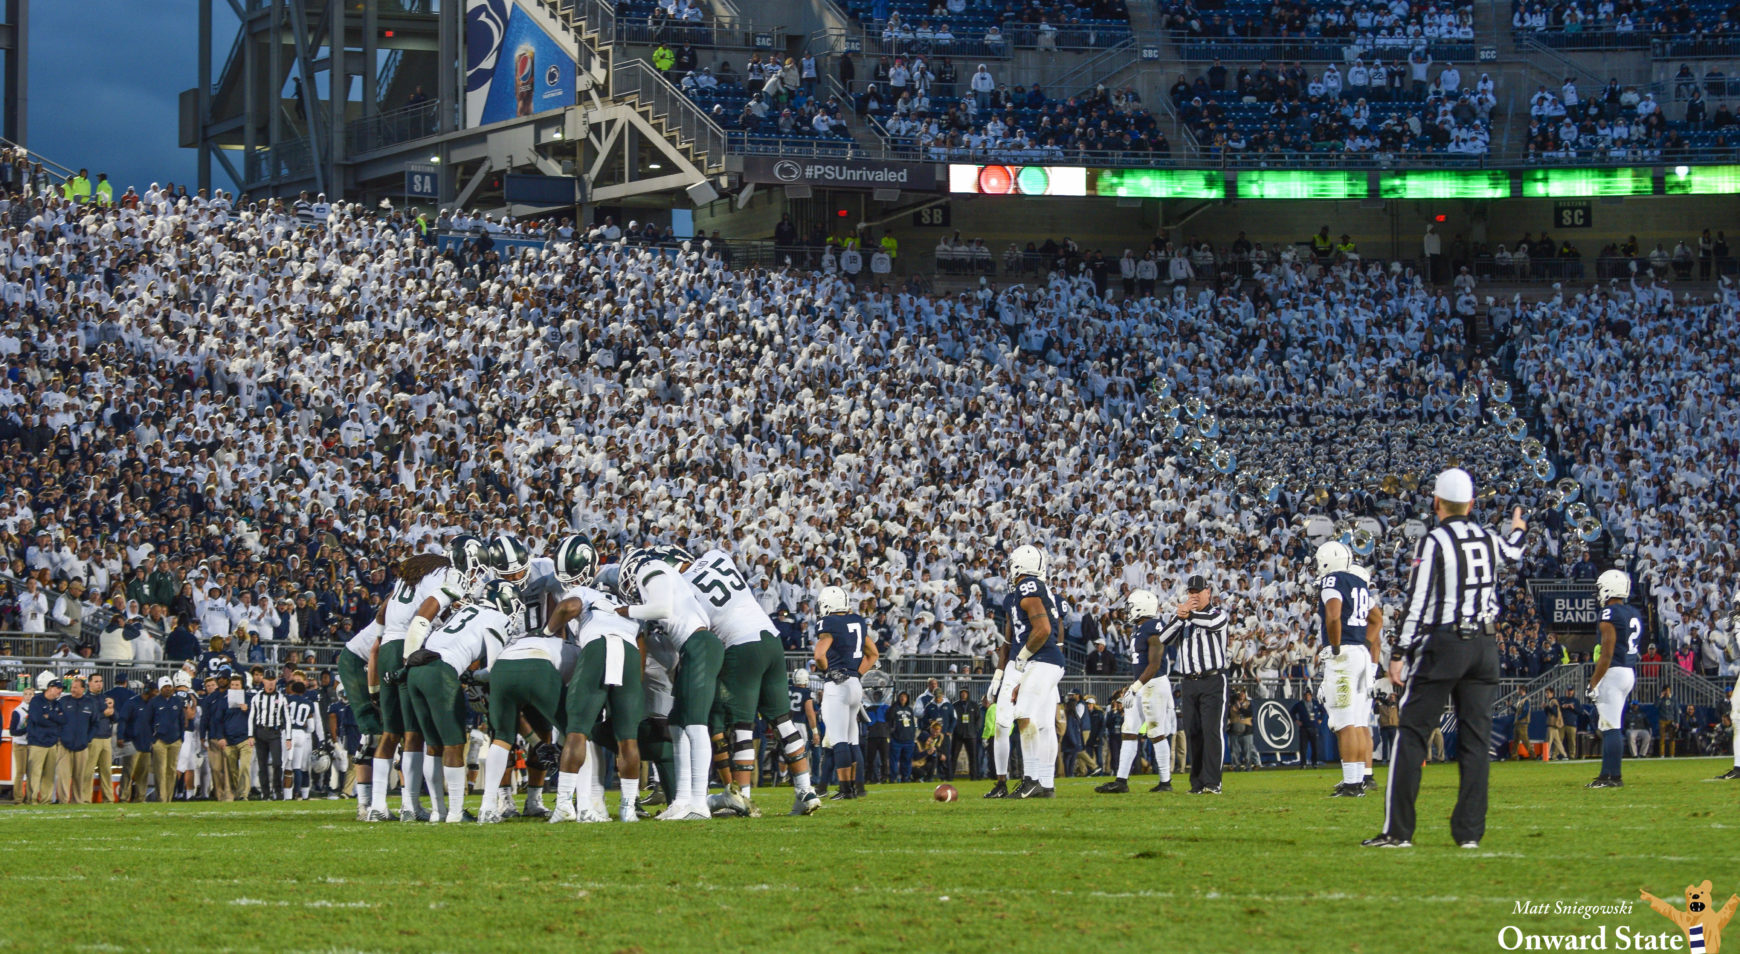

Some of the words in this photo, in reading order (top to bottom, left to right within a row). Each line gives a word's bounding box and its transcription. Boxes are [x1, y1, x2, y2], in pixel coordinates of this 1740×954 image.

[755, 36, 772, 46] SAC
[1142, 49, 1159, 58] SBC
[1480, 50, 1496, 60] SCC
[804, 165, 908, 182] #PSUnrivaled
[413, 174, 432, 192] SA
[921, 208, 943, 224] SB
[1562, 209, 1585, 226] SC
[1461, 542, 1492, 584] R
[691, 557, 746, 608] 55
[1020, 581, 1038, 596] 99
[1322, 576, 1337, 588] 18
[1347, 587, 1368, 626] 18
[1554, 599, 1596, 610] BLUE
[1553, 611, 1598, 622] BAND
[1602, 608, 1612, 620] 2
[816, 620, 824, 631] 7
[1155, 622, 1164, 632] 4
[847, 622, 862, 658] 7
[1627, 618, 1641, 654] 2
[290, 701, 310, 726] 10
